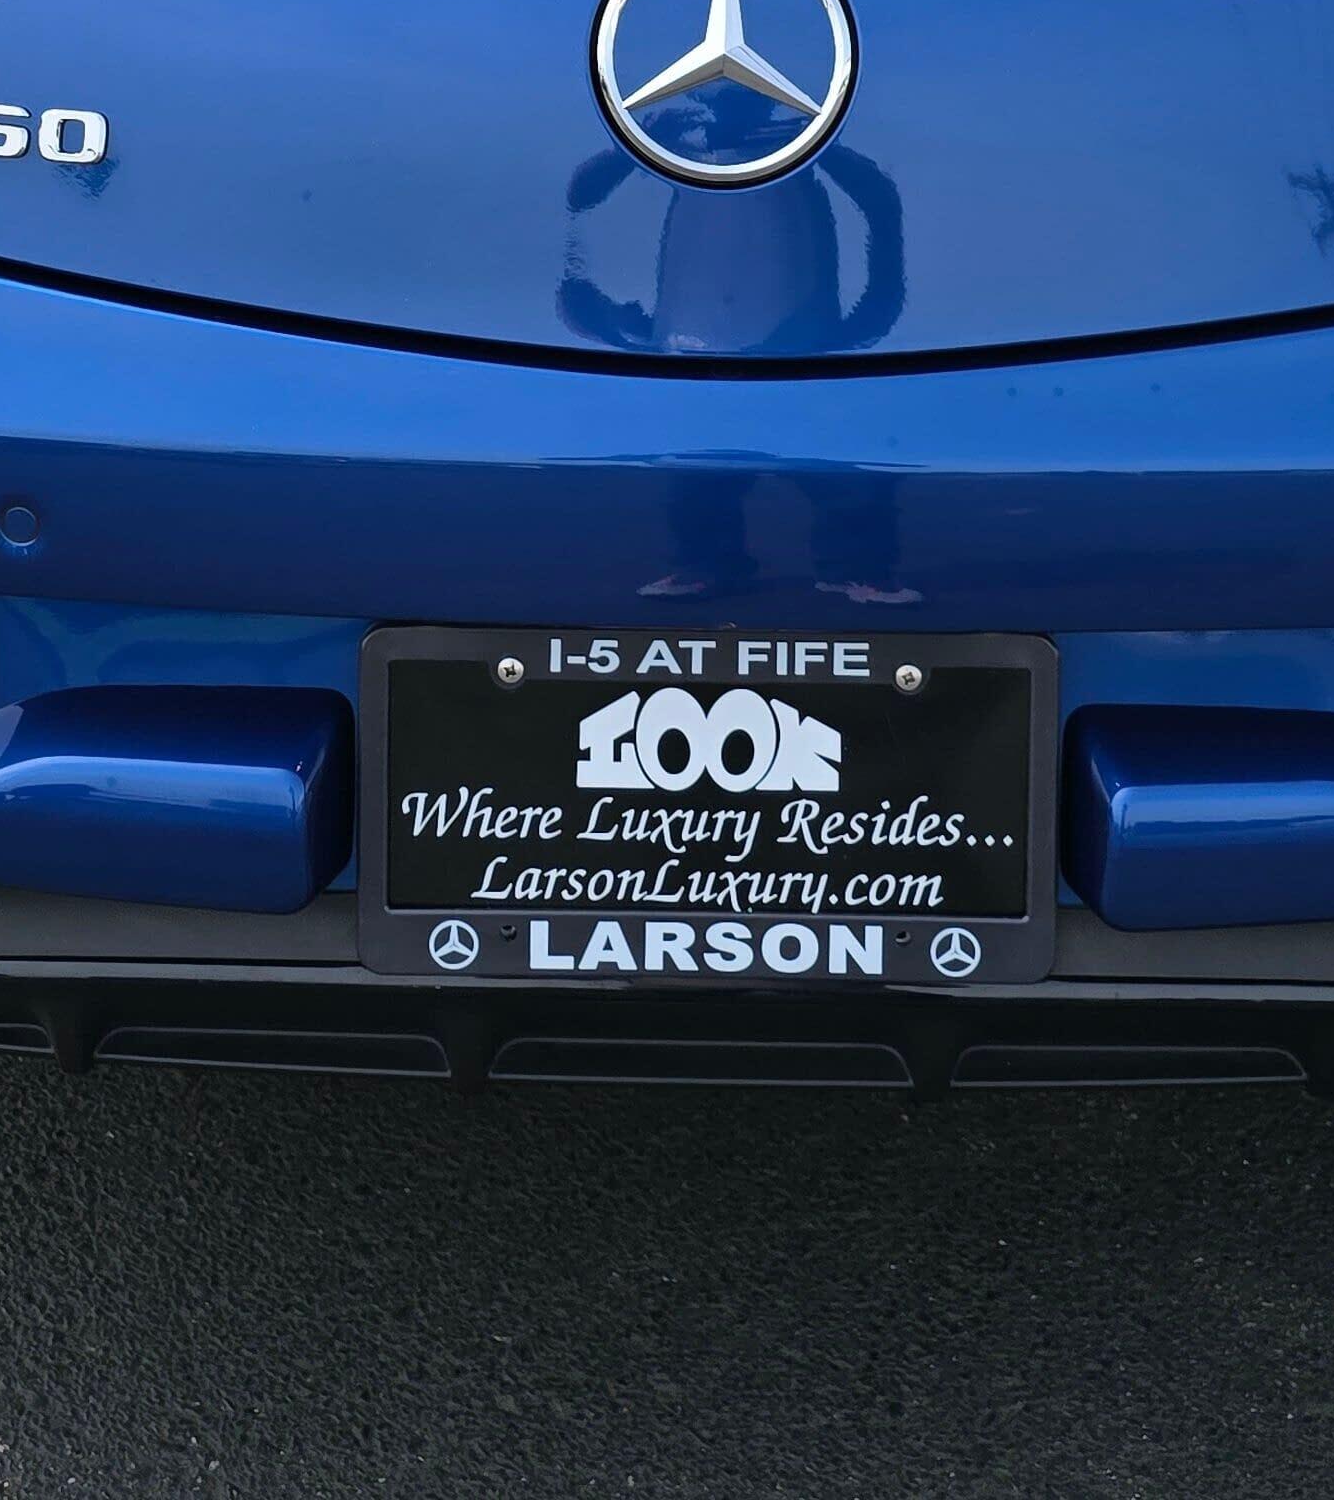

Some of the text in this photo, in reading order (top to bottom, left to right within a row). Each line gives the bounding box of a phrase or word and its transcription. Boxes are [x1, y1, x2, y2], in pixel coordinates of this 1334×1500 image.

[549, 638, 871, 678] I-5 AT FIFE
[576, 687, 842, 793] LOOK
[400, 786, 1014, 863] Where Luxury Resides...
[470, 855, 944, 914] LarsonLuxury.com
[528, 919, 884, 976] LARSON
